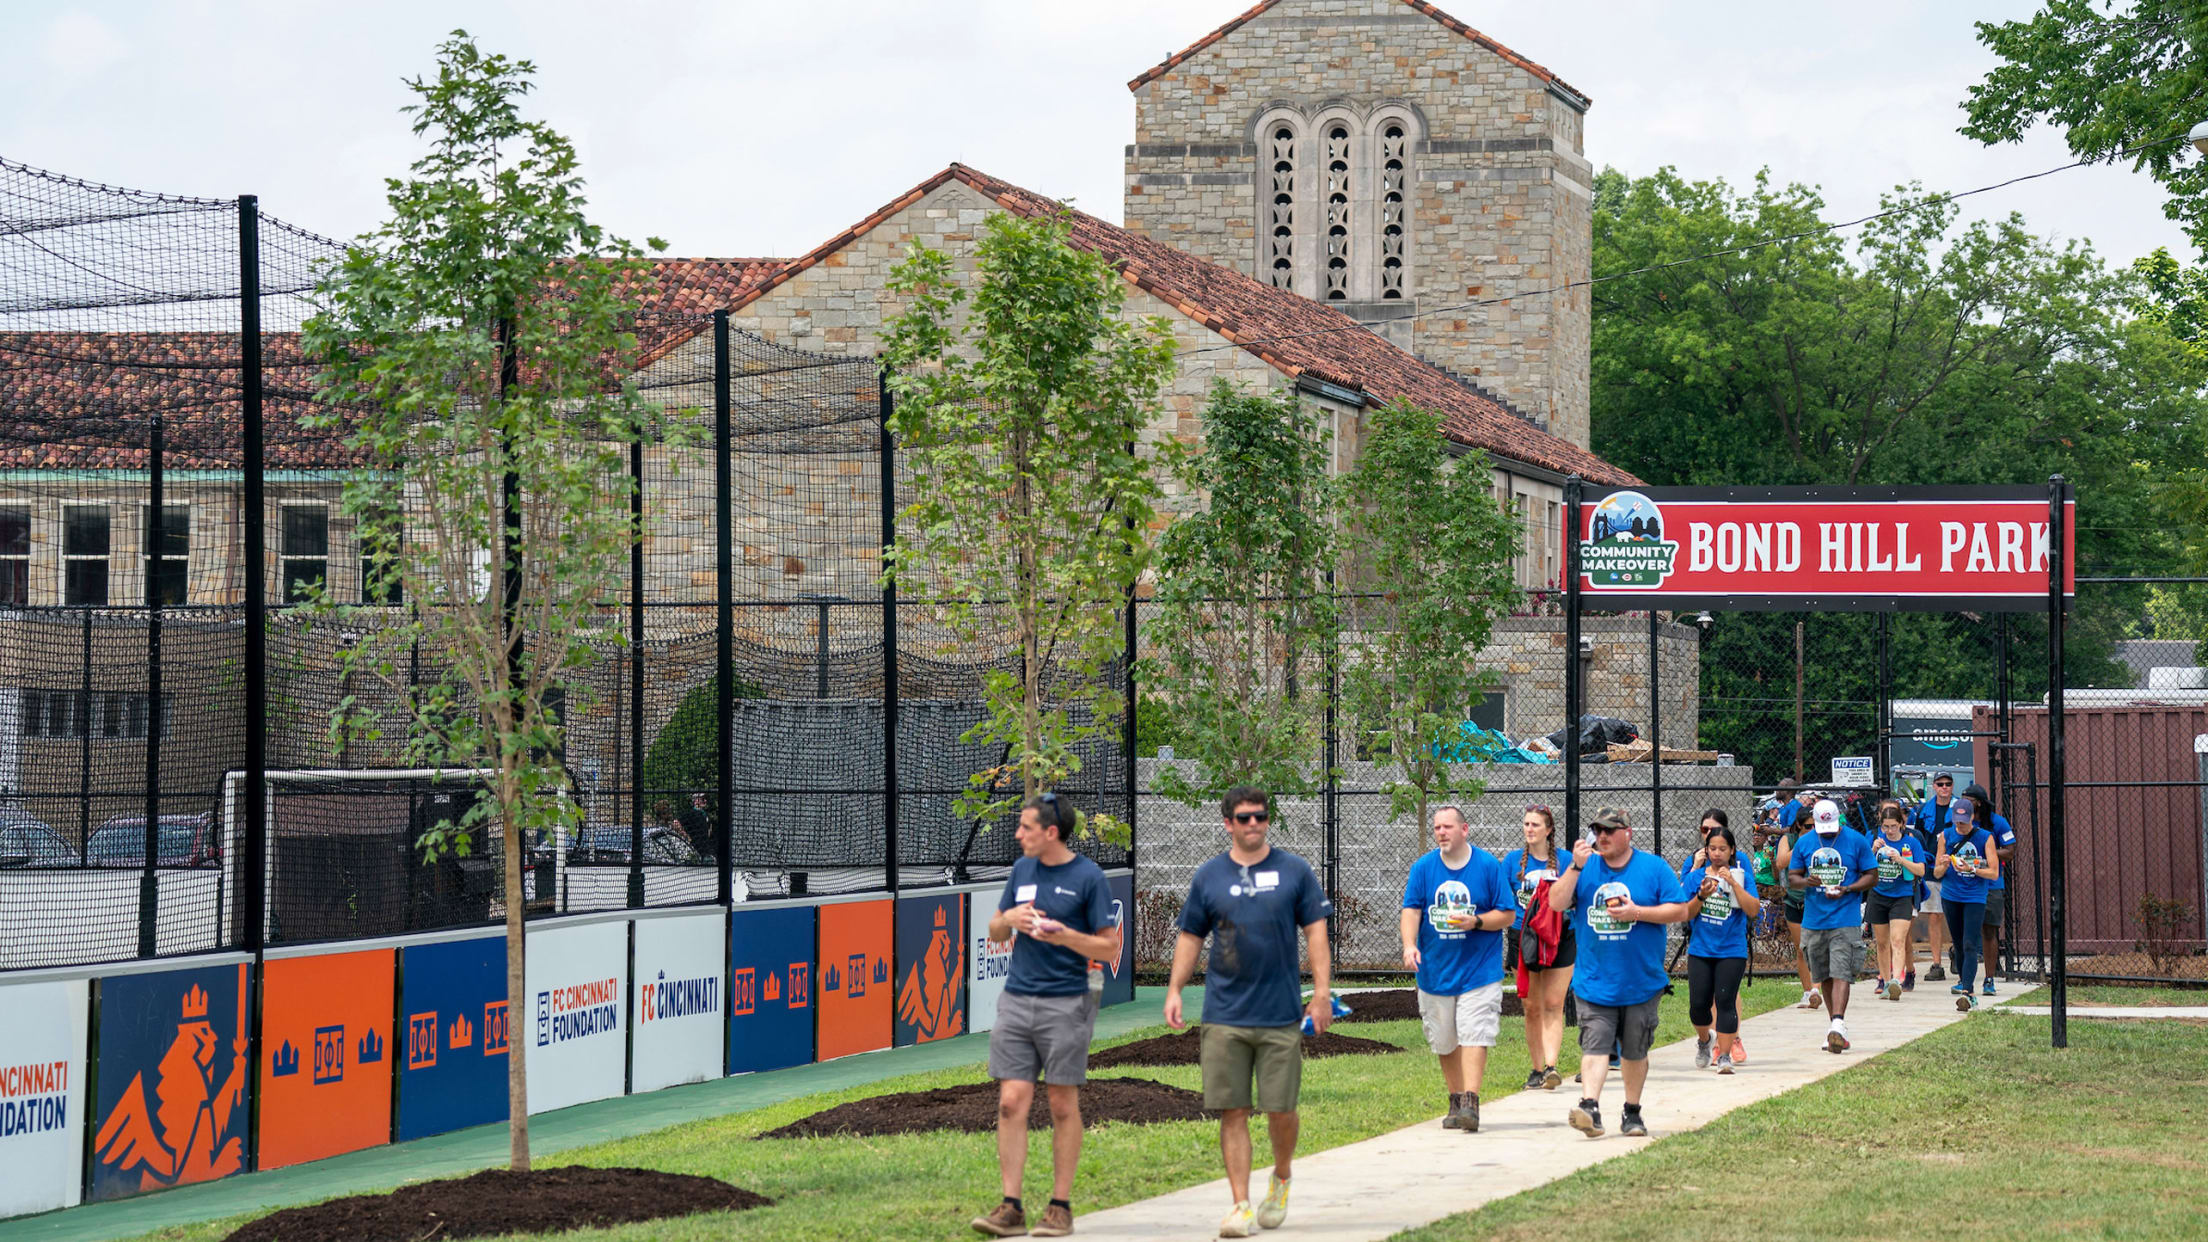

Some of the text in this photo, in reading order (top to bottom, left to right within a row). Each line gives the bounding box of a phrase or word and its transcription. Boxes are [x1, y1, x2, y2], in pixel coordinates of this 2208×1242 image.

[1580, 546, 1672, 558] COMMUNITY
[1582, 559, 1667, 571] MAKEOVER
[1688, 521, 2050, 573] BOND HILL PARK
[1835, 759, 1869, 768] NOTICE
[553, 977, 617, 1014] FC CINCINNATI
[641, 976, 718, 1025] FC CINCINNATI
[553, 1004, 617, 1043] FOUNDATION
